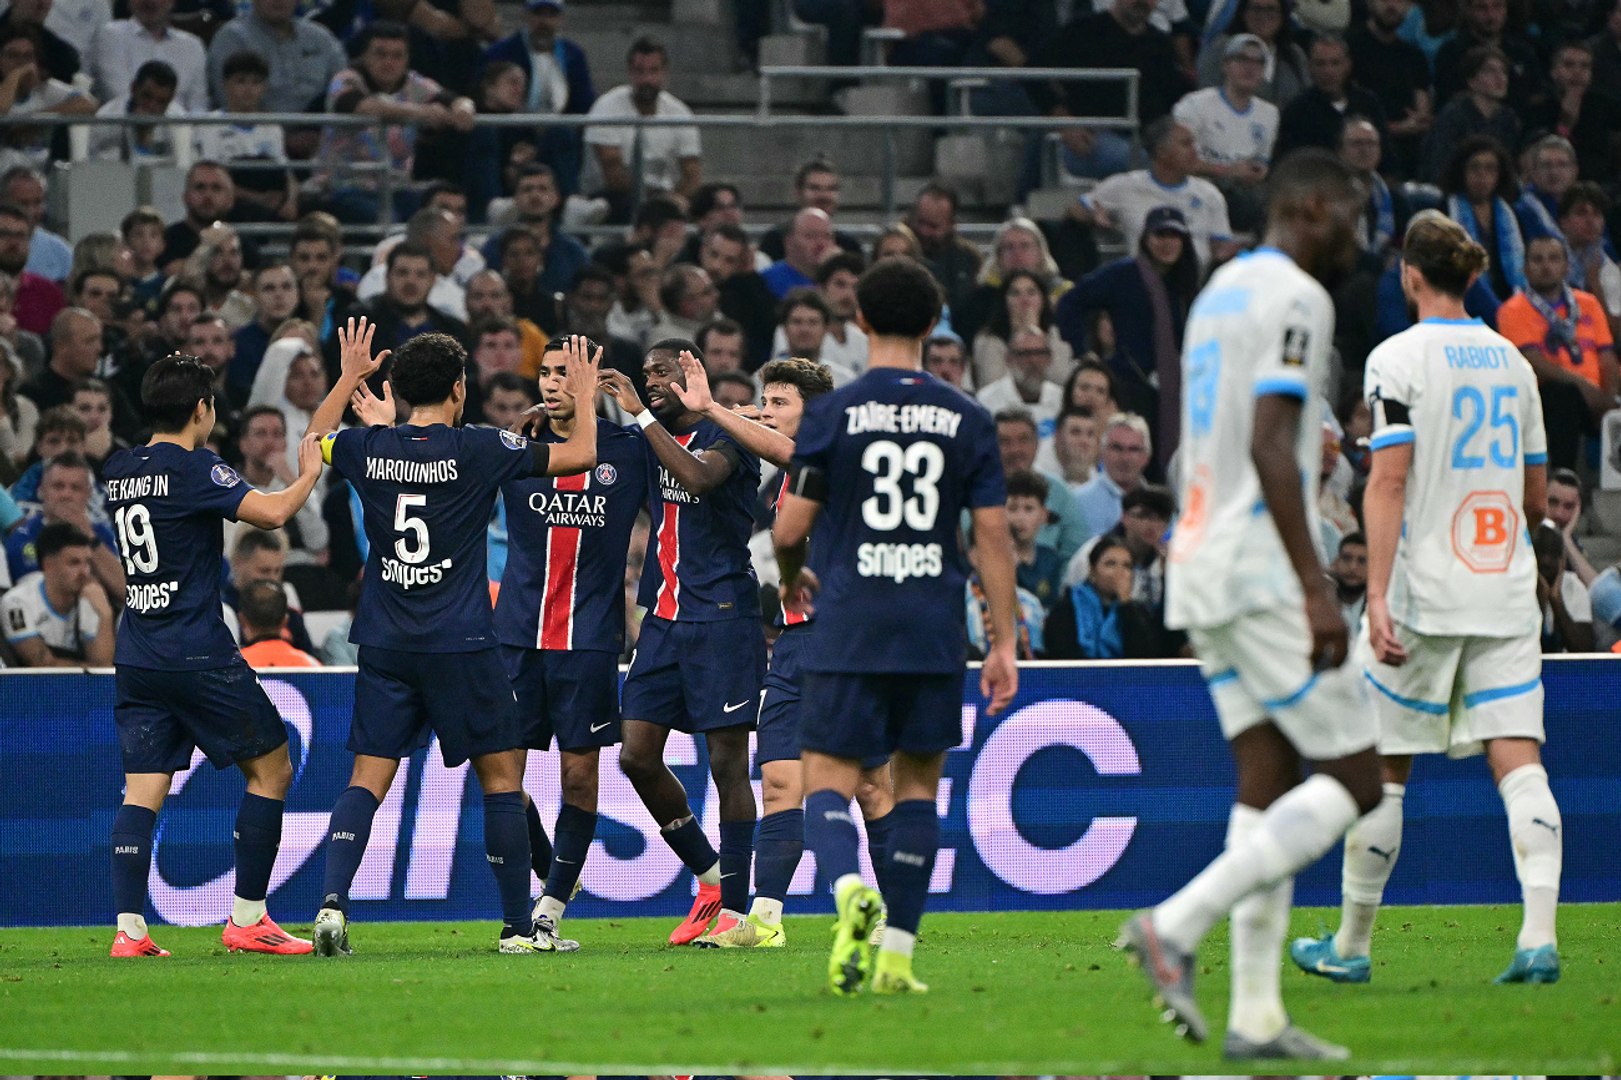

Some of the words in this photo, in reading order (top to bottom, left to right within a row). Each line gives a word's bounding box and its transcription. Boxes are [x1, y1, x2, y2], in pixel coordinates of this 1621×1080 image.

[1443, 345, 1510, 370] RABIOT
[1450, 385, 1519, 470] 25
[365, 456, 459, 484] MARQUINHOS
[861, 440, 945, 531] 33
[107, 479, 120, 502] EE
[120, 475, 151, 500] KANG
[152, 474, 169, 497] IN
[528, 492, 607, 515] QATAR
[394, 493, 430, 564] 5
[545, 512, 606, 528] AIRWAYS
[1472, 508, 1507, 545] B
[114, 503, 159, 576] 19
[856, 541, 943, 584] snipes
[114, 845, 139, 855] PARIS
